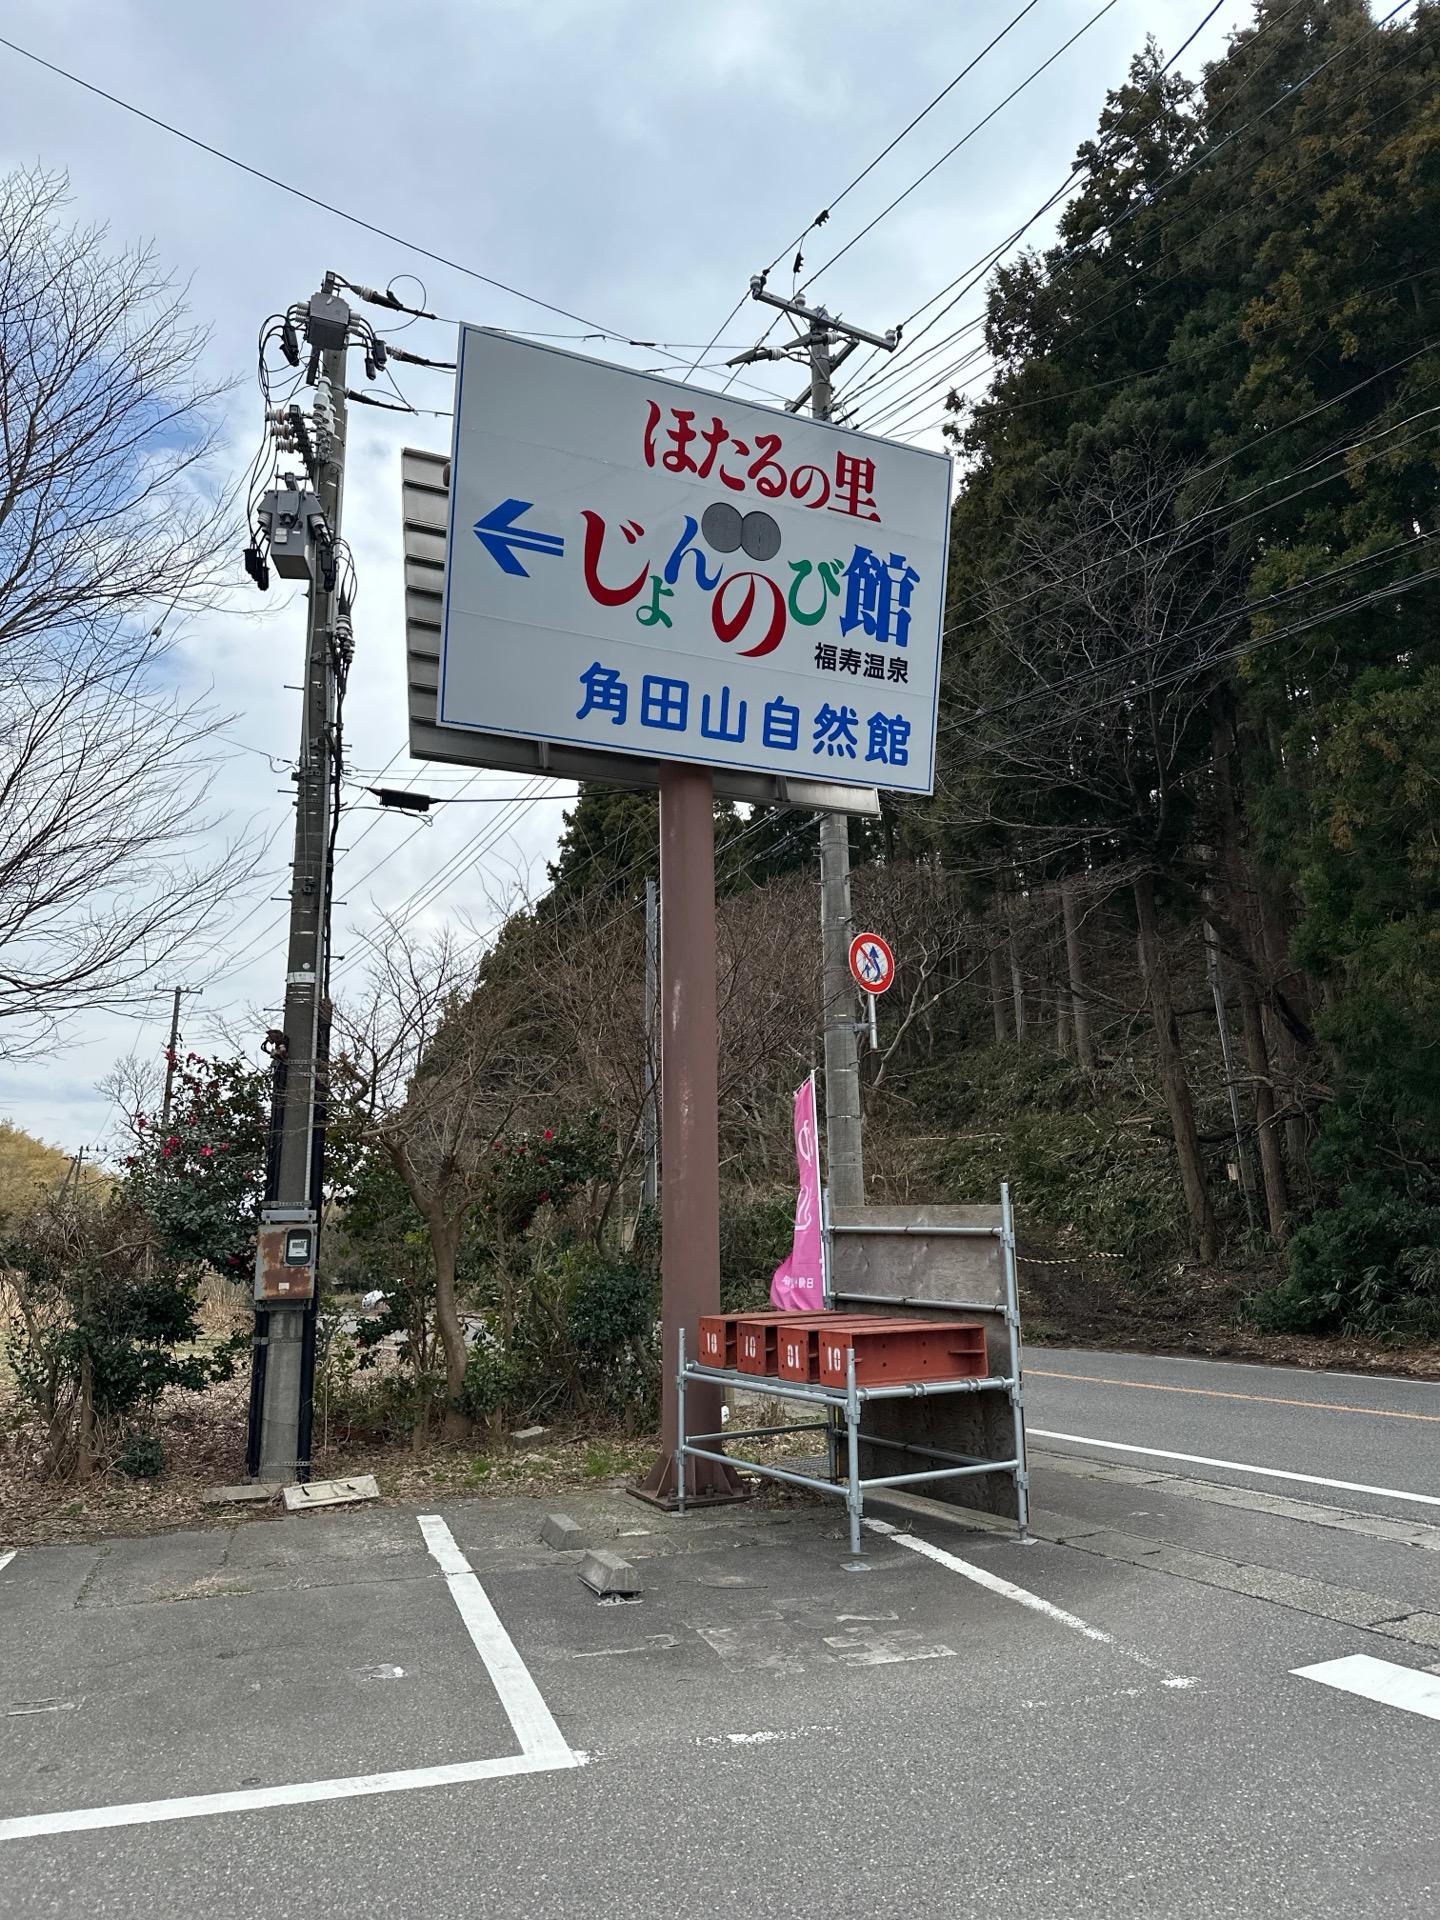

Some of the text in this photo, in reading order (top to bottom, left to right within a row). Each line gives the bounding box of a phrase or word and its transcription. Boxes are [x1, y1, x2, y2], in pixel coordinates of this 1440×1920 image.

[644, 399, 881, 523] ほたるの里
[580, 509, 920, 657] じょんのび館
[814, 642, 909, 684] 福寿温泉
[576, 661, 911, 767] 角田山自然館
[706, 1332, 717, 1354] 10
[745, 1335, 756, 1358] 10
[828, 1346, 841, 1371] 10
